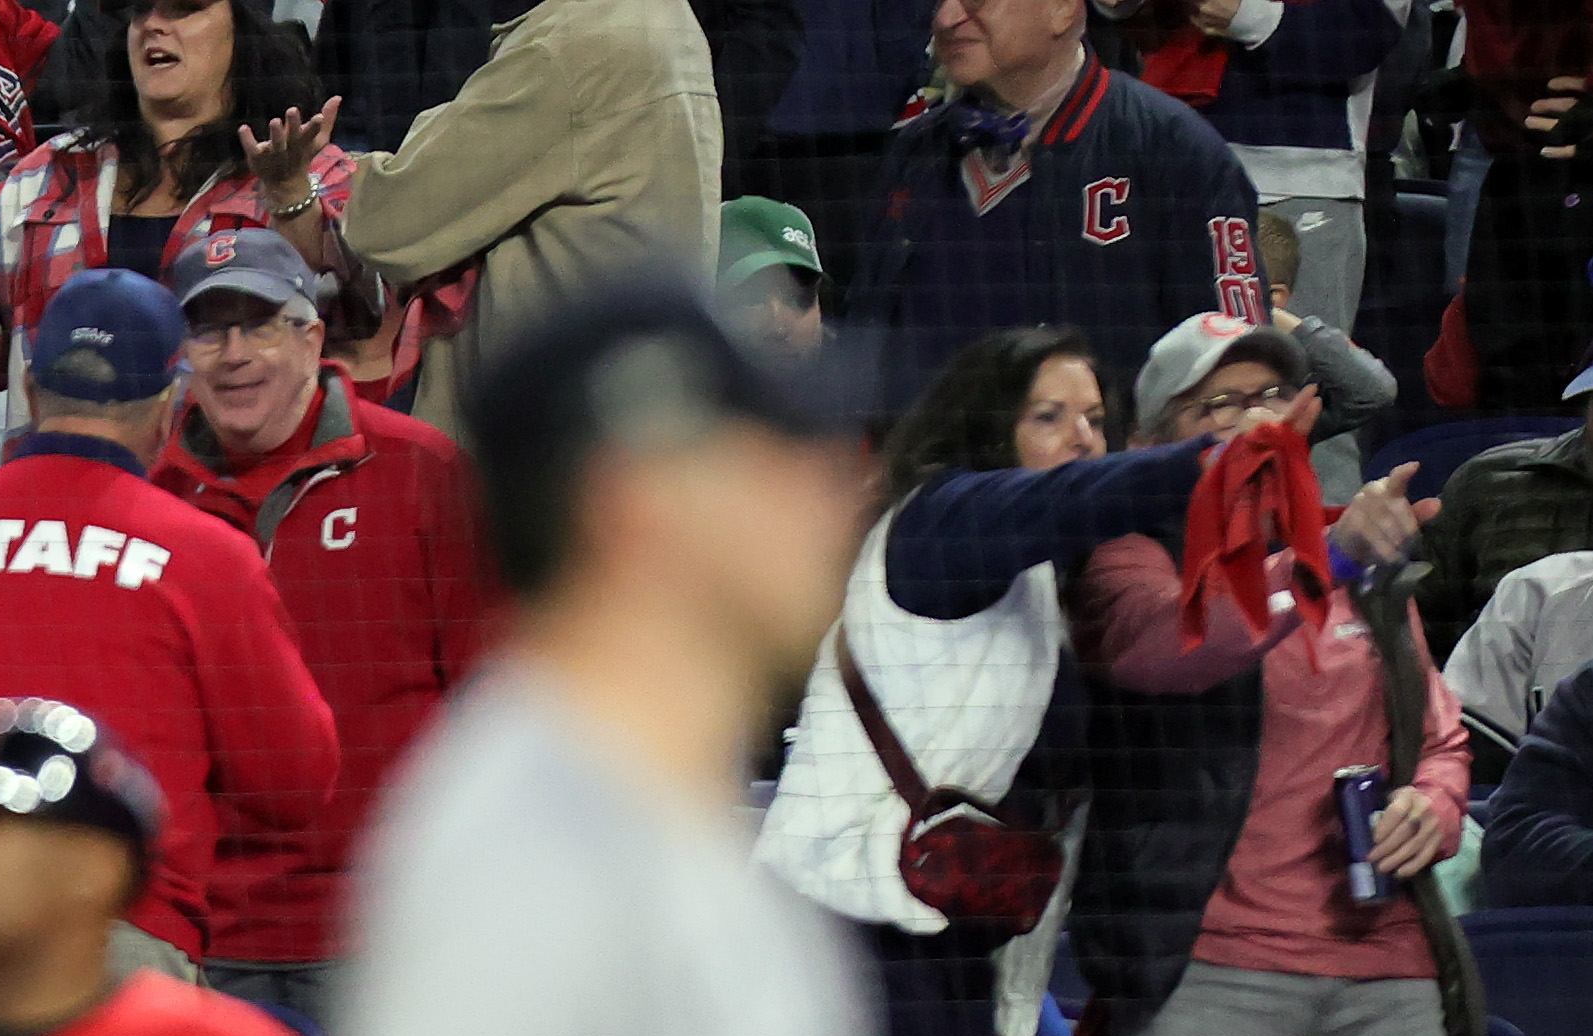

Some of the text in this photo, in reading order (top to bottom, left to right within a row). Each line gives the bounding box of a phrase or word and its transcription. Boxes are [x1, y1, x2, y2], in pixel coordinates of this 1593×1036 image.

[1082, 176, 1131, 246] C
[206, 236, 237, 267] C
[1208, 216, 1257, 277] 19
[321, 507, 358, 551] C
